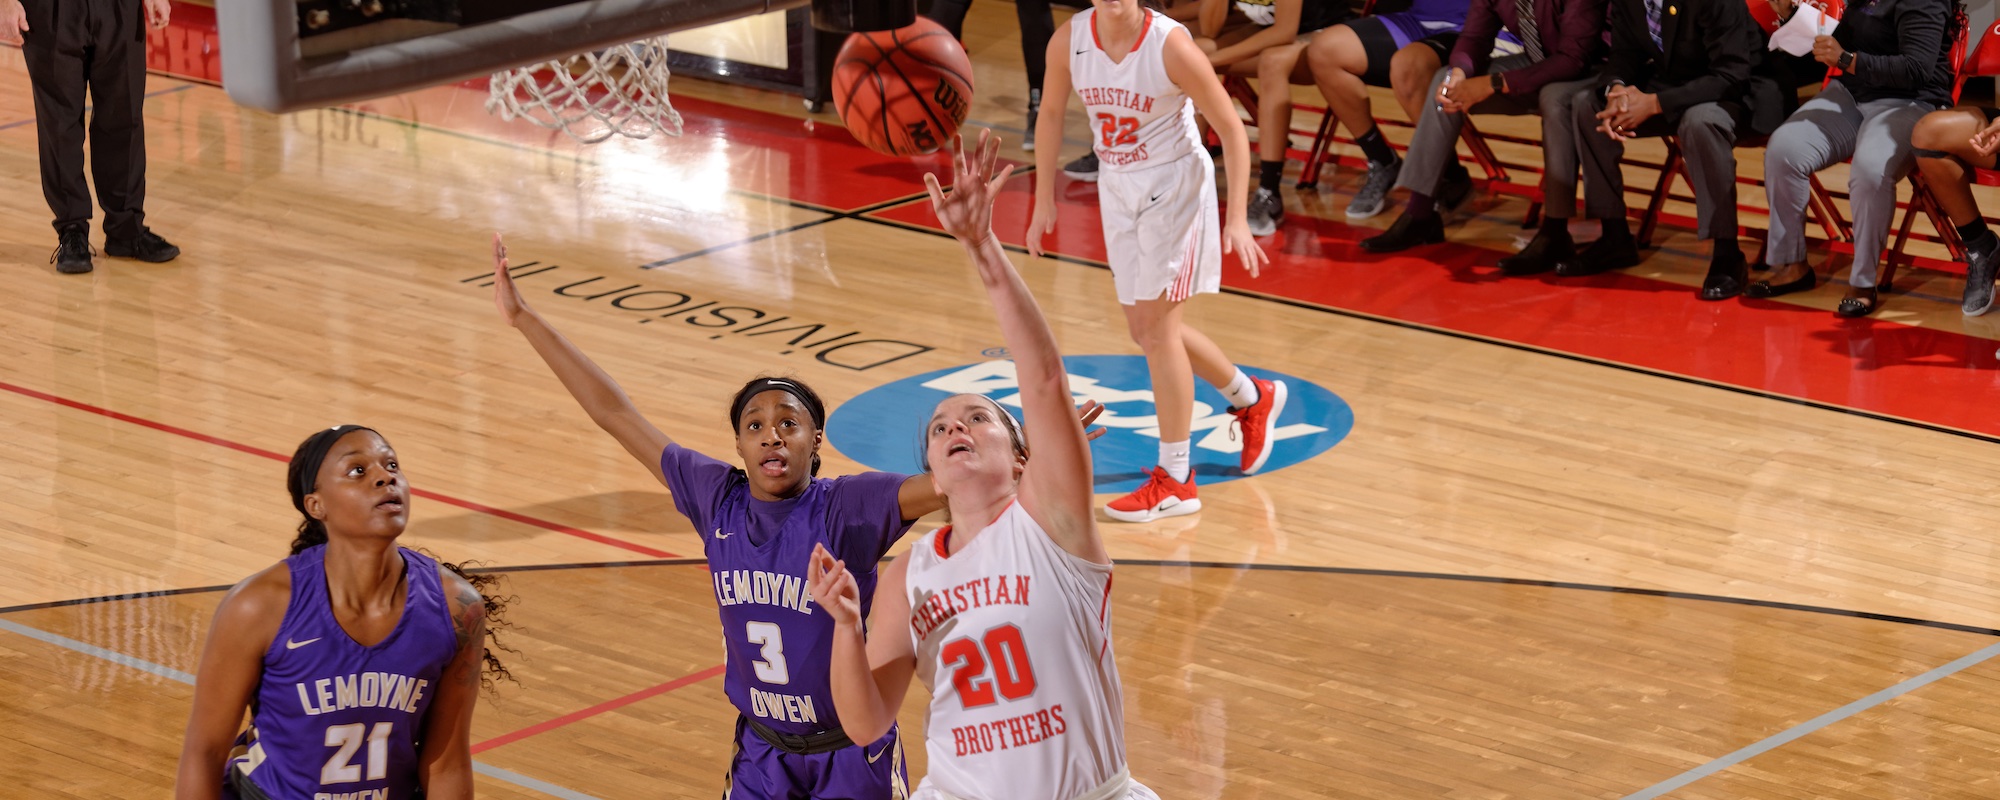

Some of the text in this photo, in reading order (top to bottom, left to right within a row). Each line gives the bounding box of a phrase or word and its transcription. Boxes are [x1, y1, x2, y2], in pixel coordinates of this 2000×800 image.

[1096, 112, 1139, 147] 22
[553, 276, 936, 371] Division
[714, 570, 814, 615] LEMOYNE
[911, 575, 1031, 641] CHRISTIAN
[746, 620, 789, 686] 3
[940, 621, 1038, 711] 20
[296, 672, 428, 715] LEMOYNE
[750, 687, 818, 723] OWEN
[320, 722, 394, 785] 21
[952, 704, 1067, 757] BROTHERS
